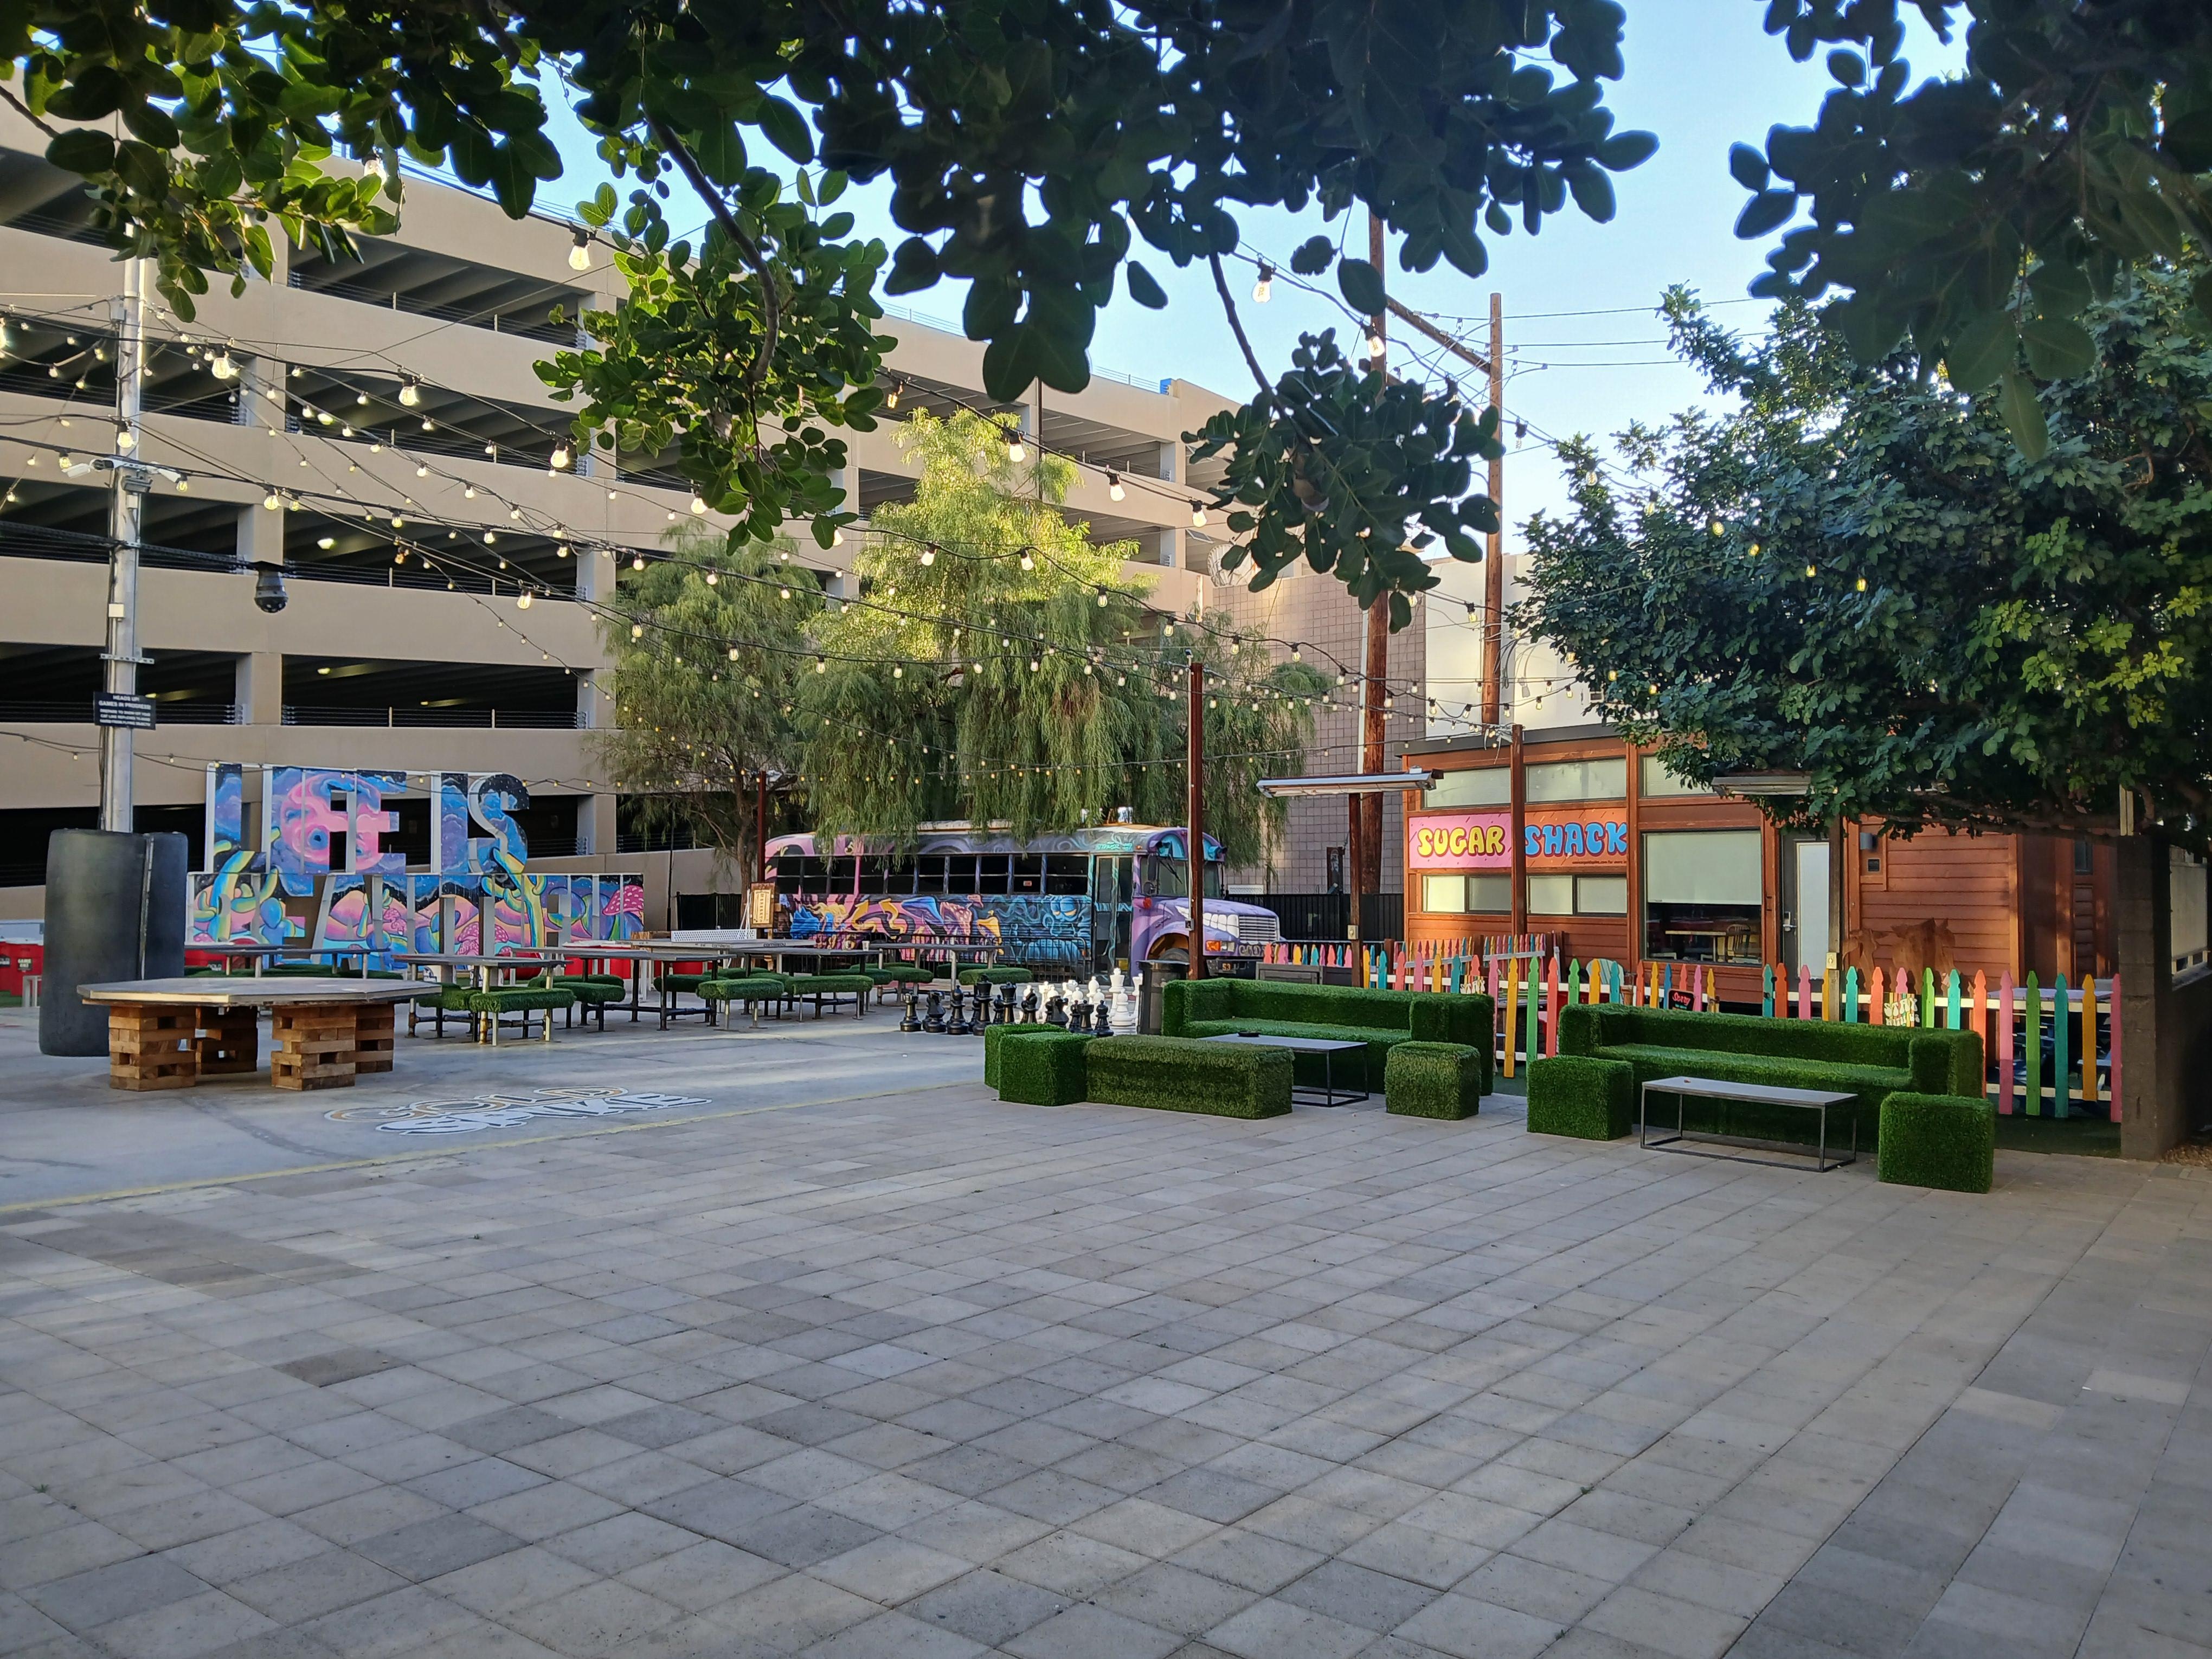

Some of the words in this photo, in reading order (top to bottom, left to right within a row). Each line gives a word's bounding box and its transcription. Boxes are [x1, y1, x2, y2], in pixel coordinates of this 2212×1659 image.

[429, 770, 530, 874] IS
[1417, 825, 1506, 857] SUGAR
[1525, 822, 1626, 857] SHACK
[1222, 963, 1231, 971] 53
[1460, 979, 1486, 994] STAY
[1672, 992, 1691, 1006] Sorry
[1884, 998, 1918, 1017] STAY
[324, 1085, 629, 1122] GOLD
[375, 1092, 712, 1135] SPIKE
